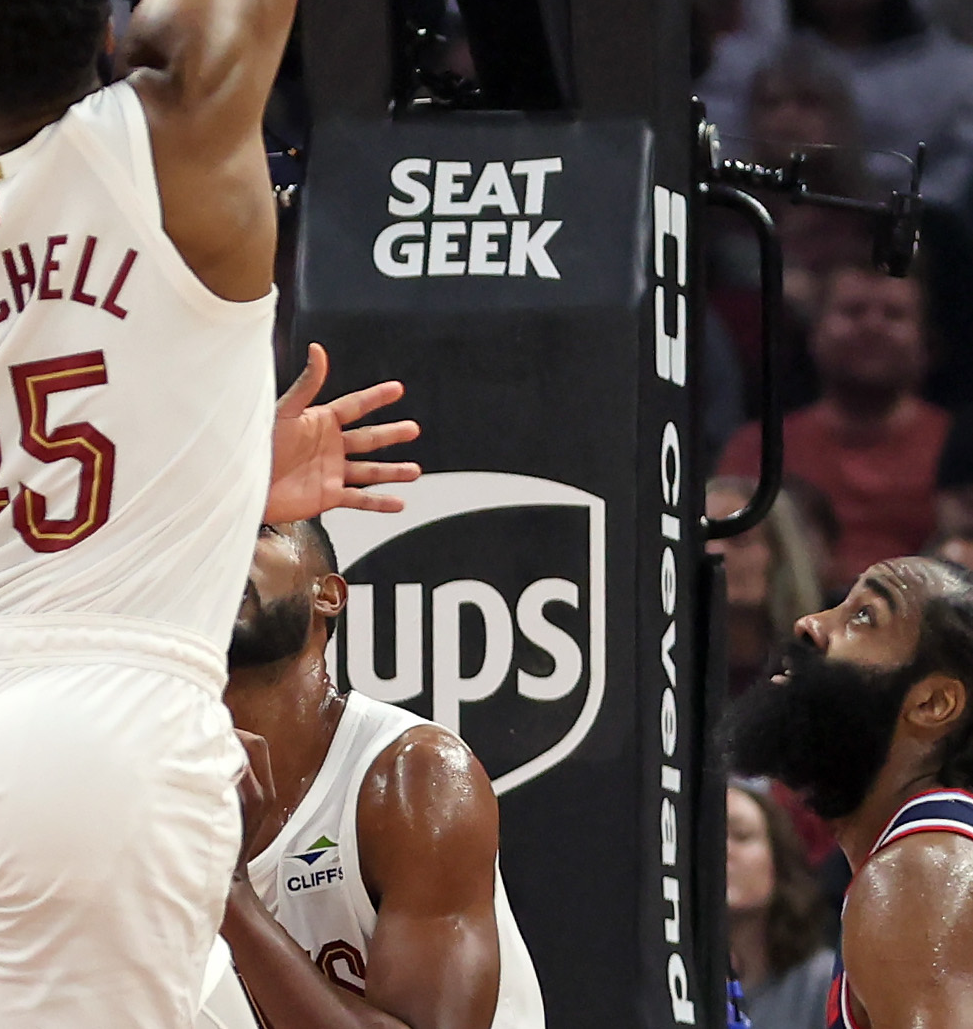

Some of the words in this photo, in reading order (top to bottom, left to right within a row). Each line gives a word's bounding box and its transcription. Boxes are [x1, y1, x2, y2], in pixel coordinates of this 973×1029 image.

[388, 157, 563, 217] SEAT
[373, 220, 563, 279] GEEK
[343, 577, 583, 738] ups
[660, 421, 696, 1024] Cleveland
